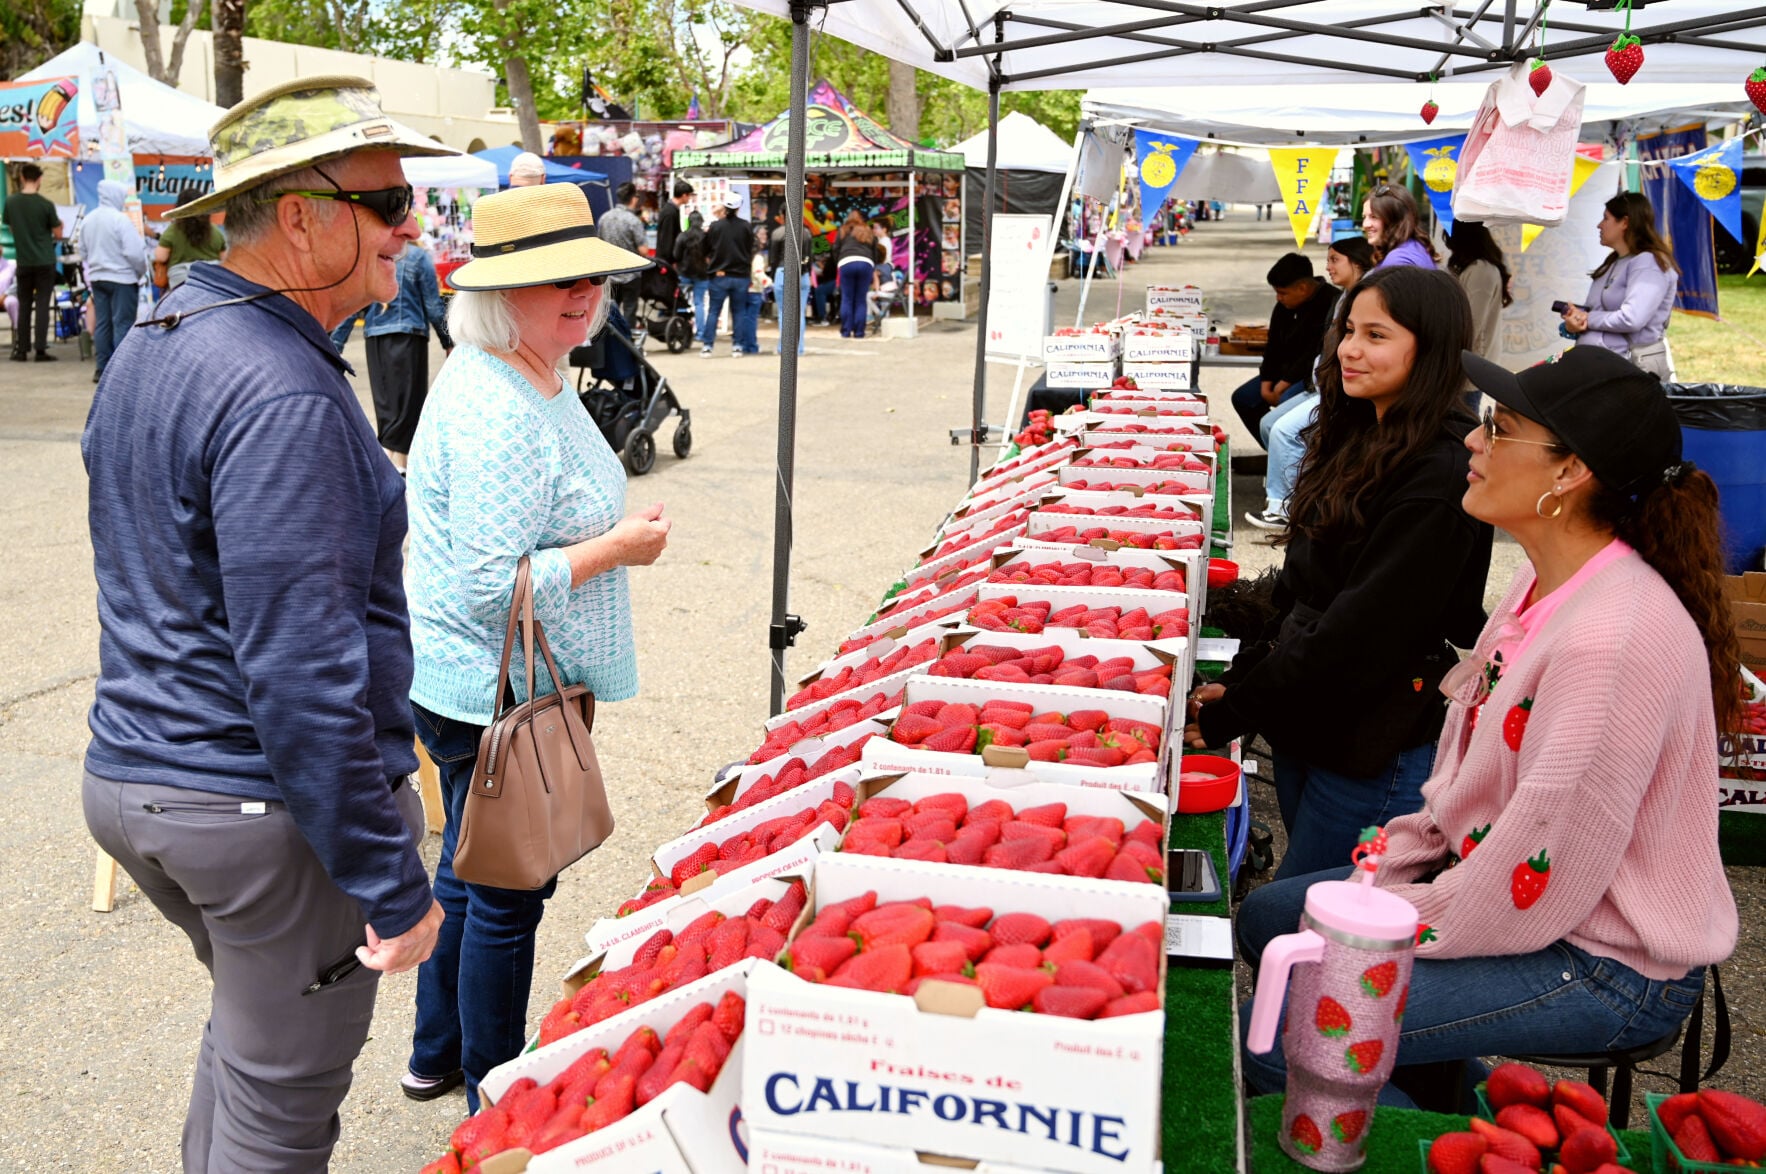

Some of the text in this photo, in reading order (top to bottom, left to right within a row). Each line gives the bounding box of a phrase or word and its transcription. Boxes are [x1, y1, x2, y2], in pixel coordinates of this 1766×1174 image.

[1294, 158, 1310, 214] FFA
[1150, 296, 1201, 306] CALIFORNIA
[1046, 343, 1106, 354] CALIFORNIA
[1129, 348, 1189, 360] CALIFORNIE
[1049, 370, 1110, 381] CALIFORNIA
[870, 1058, 1023, 1092] Fraises de
[764, 1071, 1131, 1163] CALIFORNIE
